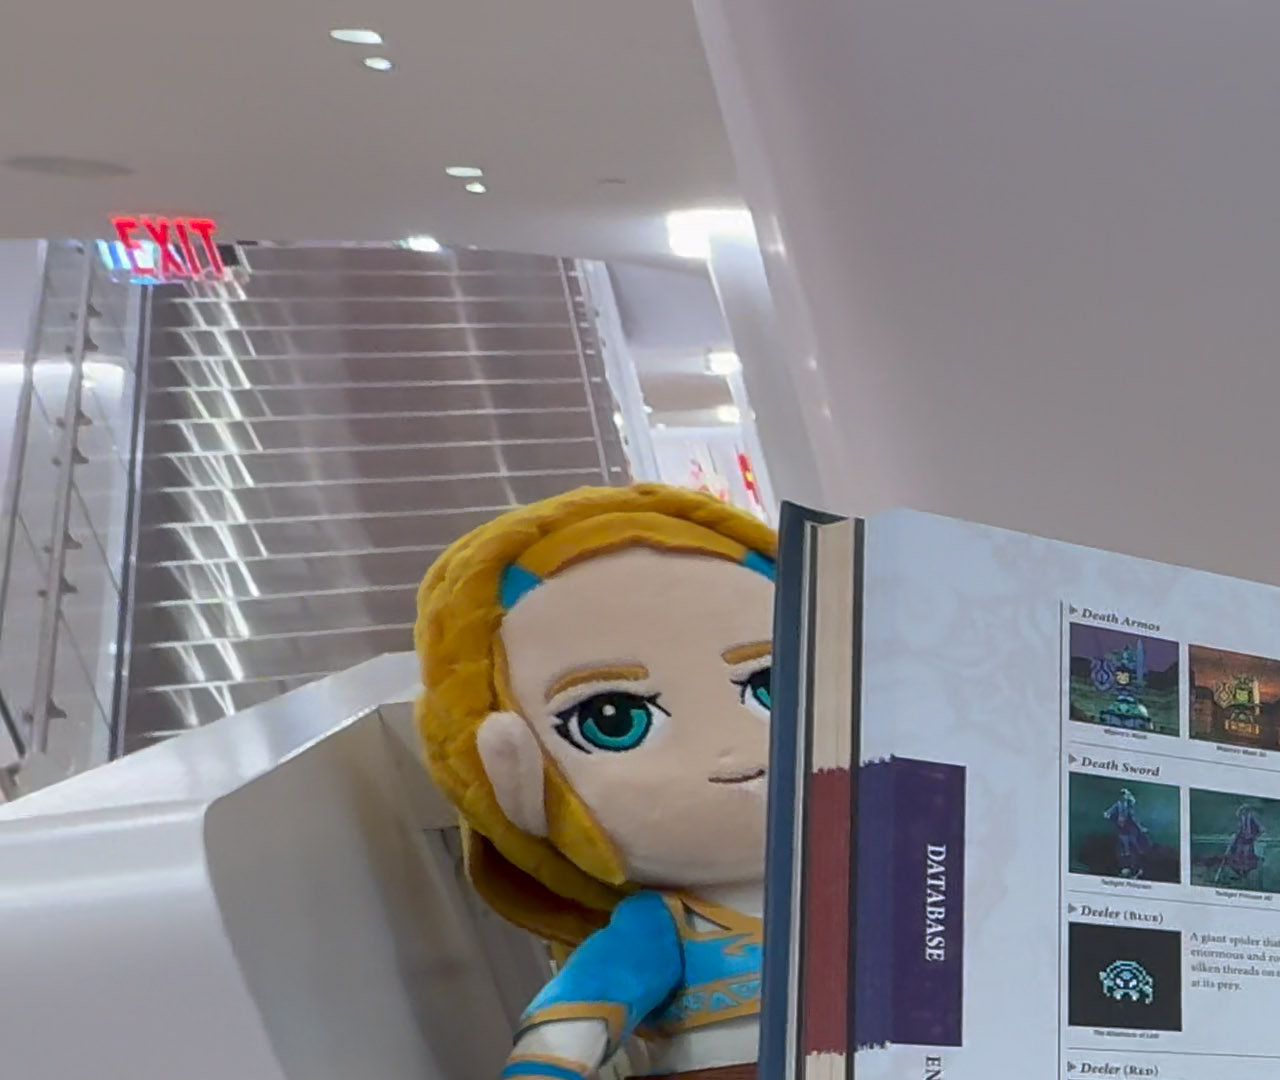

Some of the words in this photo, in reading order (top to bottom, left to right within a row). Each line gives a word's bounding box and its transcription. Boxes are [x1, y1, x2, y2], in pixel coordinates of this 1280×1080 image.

[111, 217, 225, 277] EXIT
[1081, 608, 1118, 624] Death
[1120, 616, 1160, 631] Armos
[1081, 756, 1118, 770] Death
[1121, 762, 1159, 776] Sword
[926, 844, 946, 961] DATABASE
